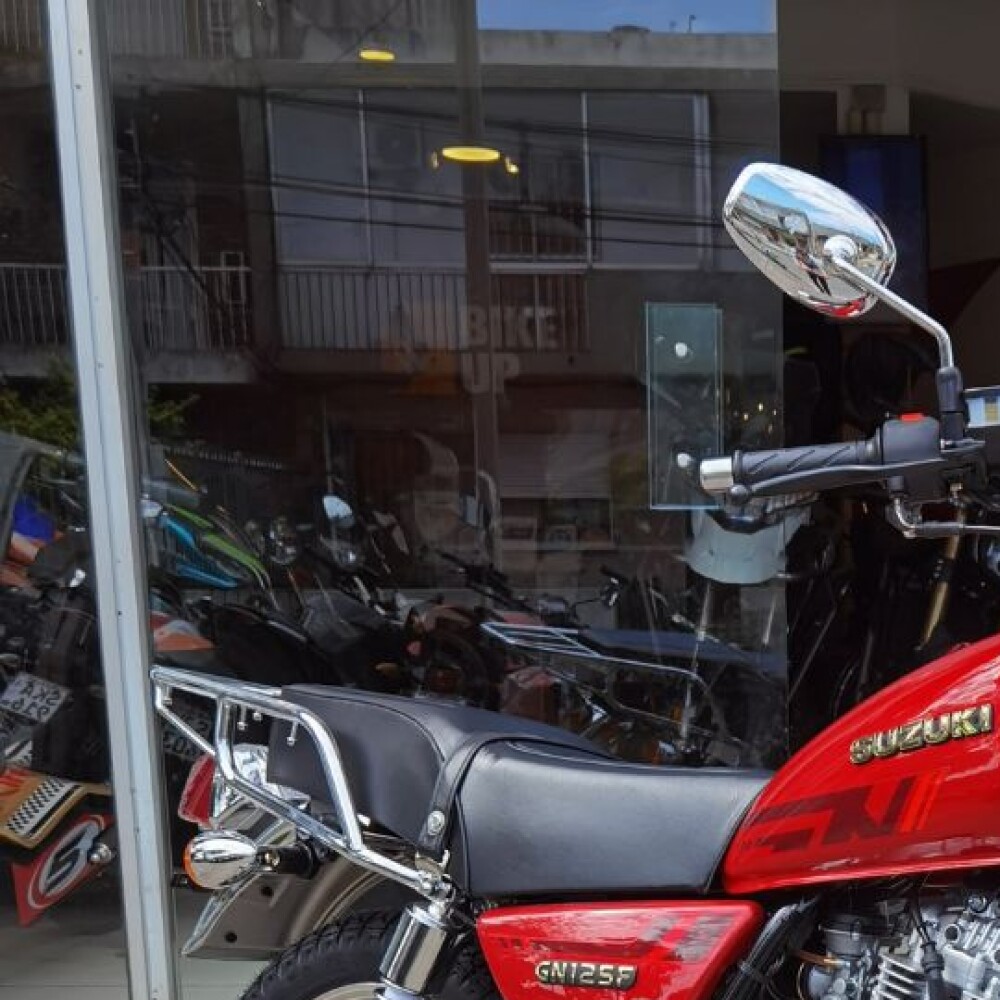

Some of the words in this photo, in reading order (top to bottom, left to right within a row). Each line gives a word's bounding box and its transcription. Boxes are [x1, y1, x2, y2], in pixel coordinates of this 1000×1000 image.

[464, 305, 557, 348] BIKE
[462, 353, 521, 394] UP
[850, 703, 992, 764] SUZUKI
[534, 960, 637, 990] GN125F
